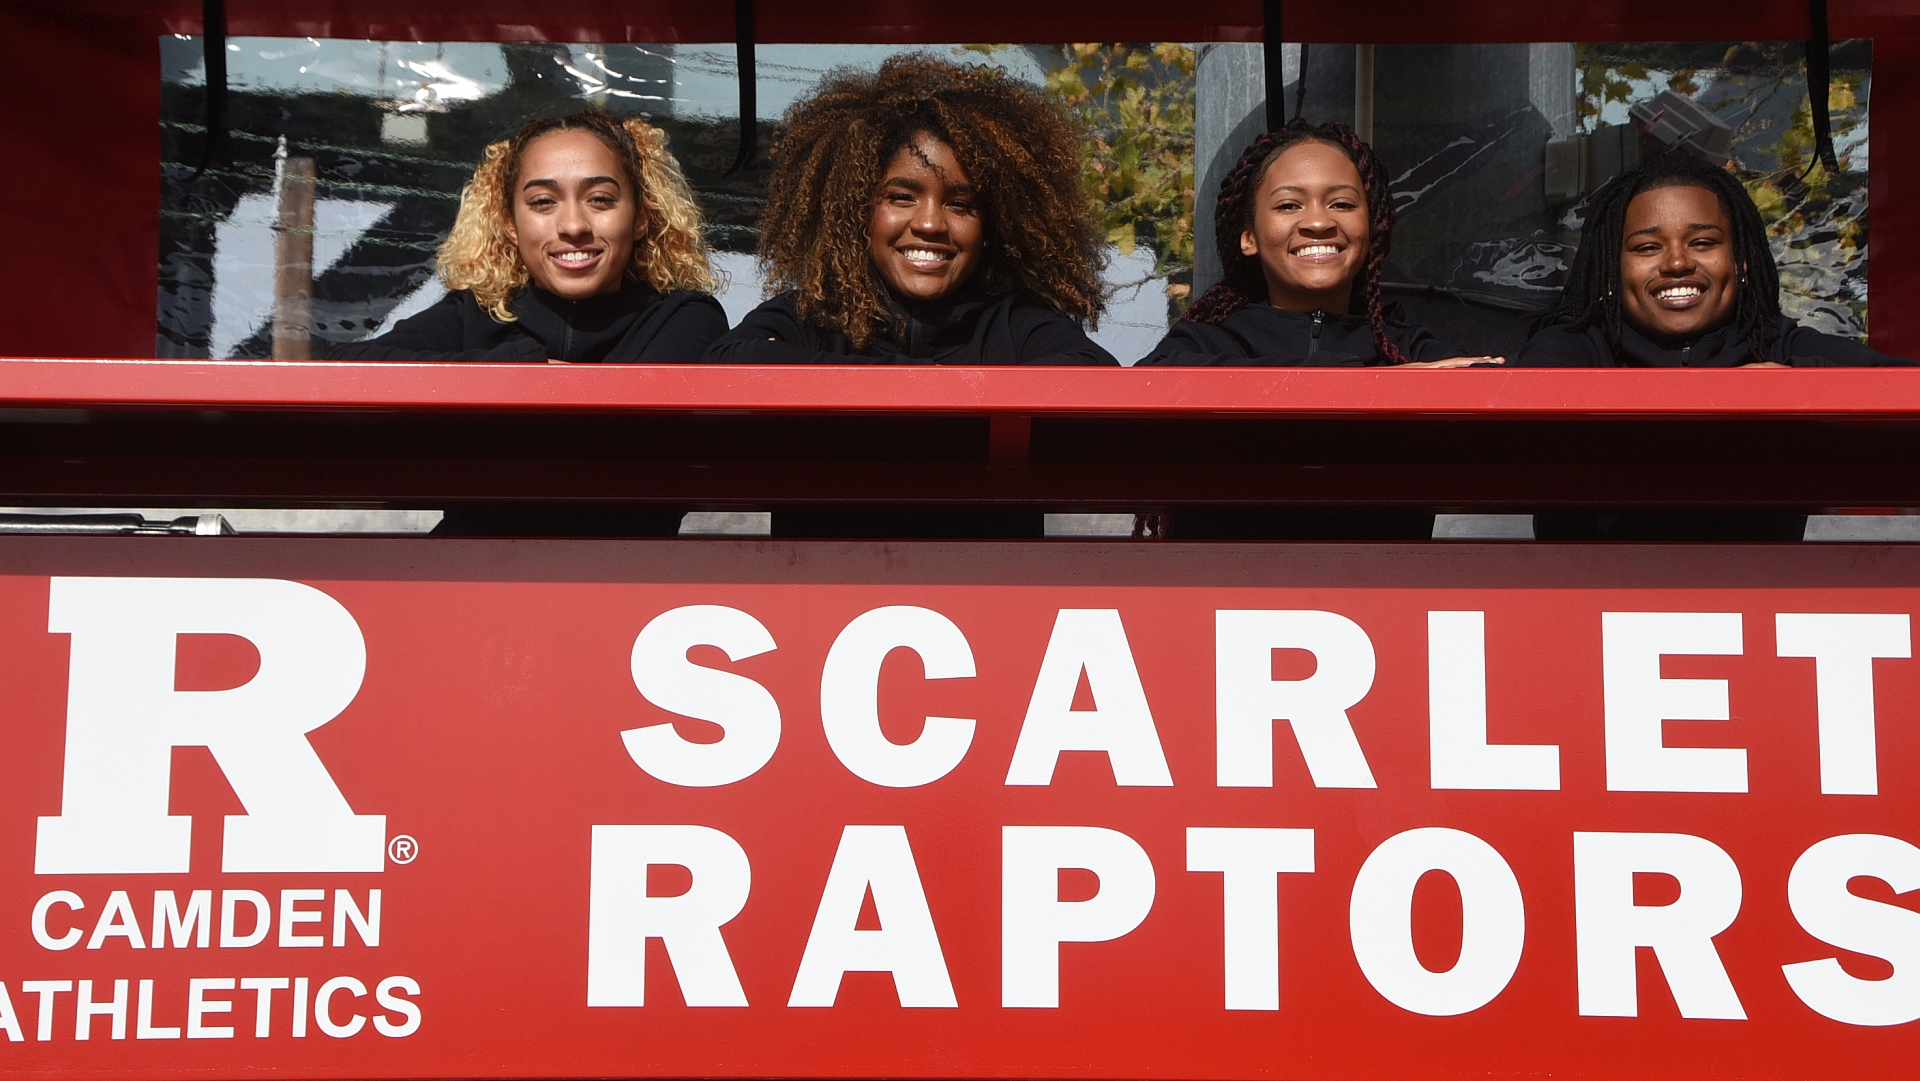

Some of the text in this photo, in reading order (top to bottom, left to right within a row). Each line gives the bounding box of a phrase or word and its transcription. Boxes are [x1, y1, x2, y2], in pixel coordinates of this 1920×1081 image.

[34, 577, 387, 875] R
[620, 604, 1912, 796] SCARLET
[31, 888, 382, 951] CAMDEN
[586, 824, 1920, 1027] RAPTORS
